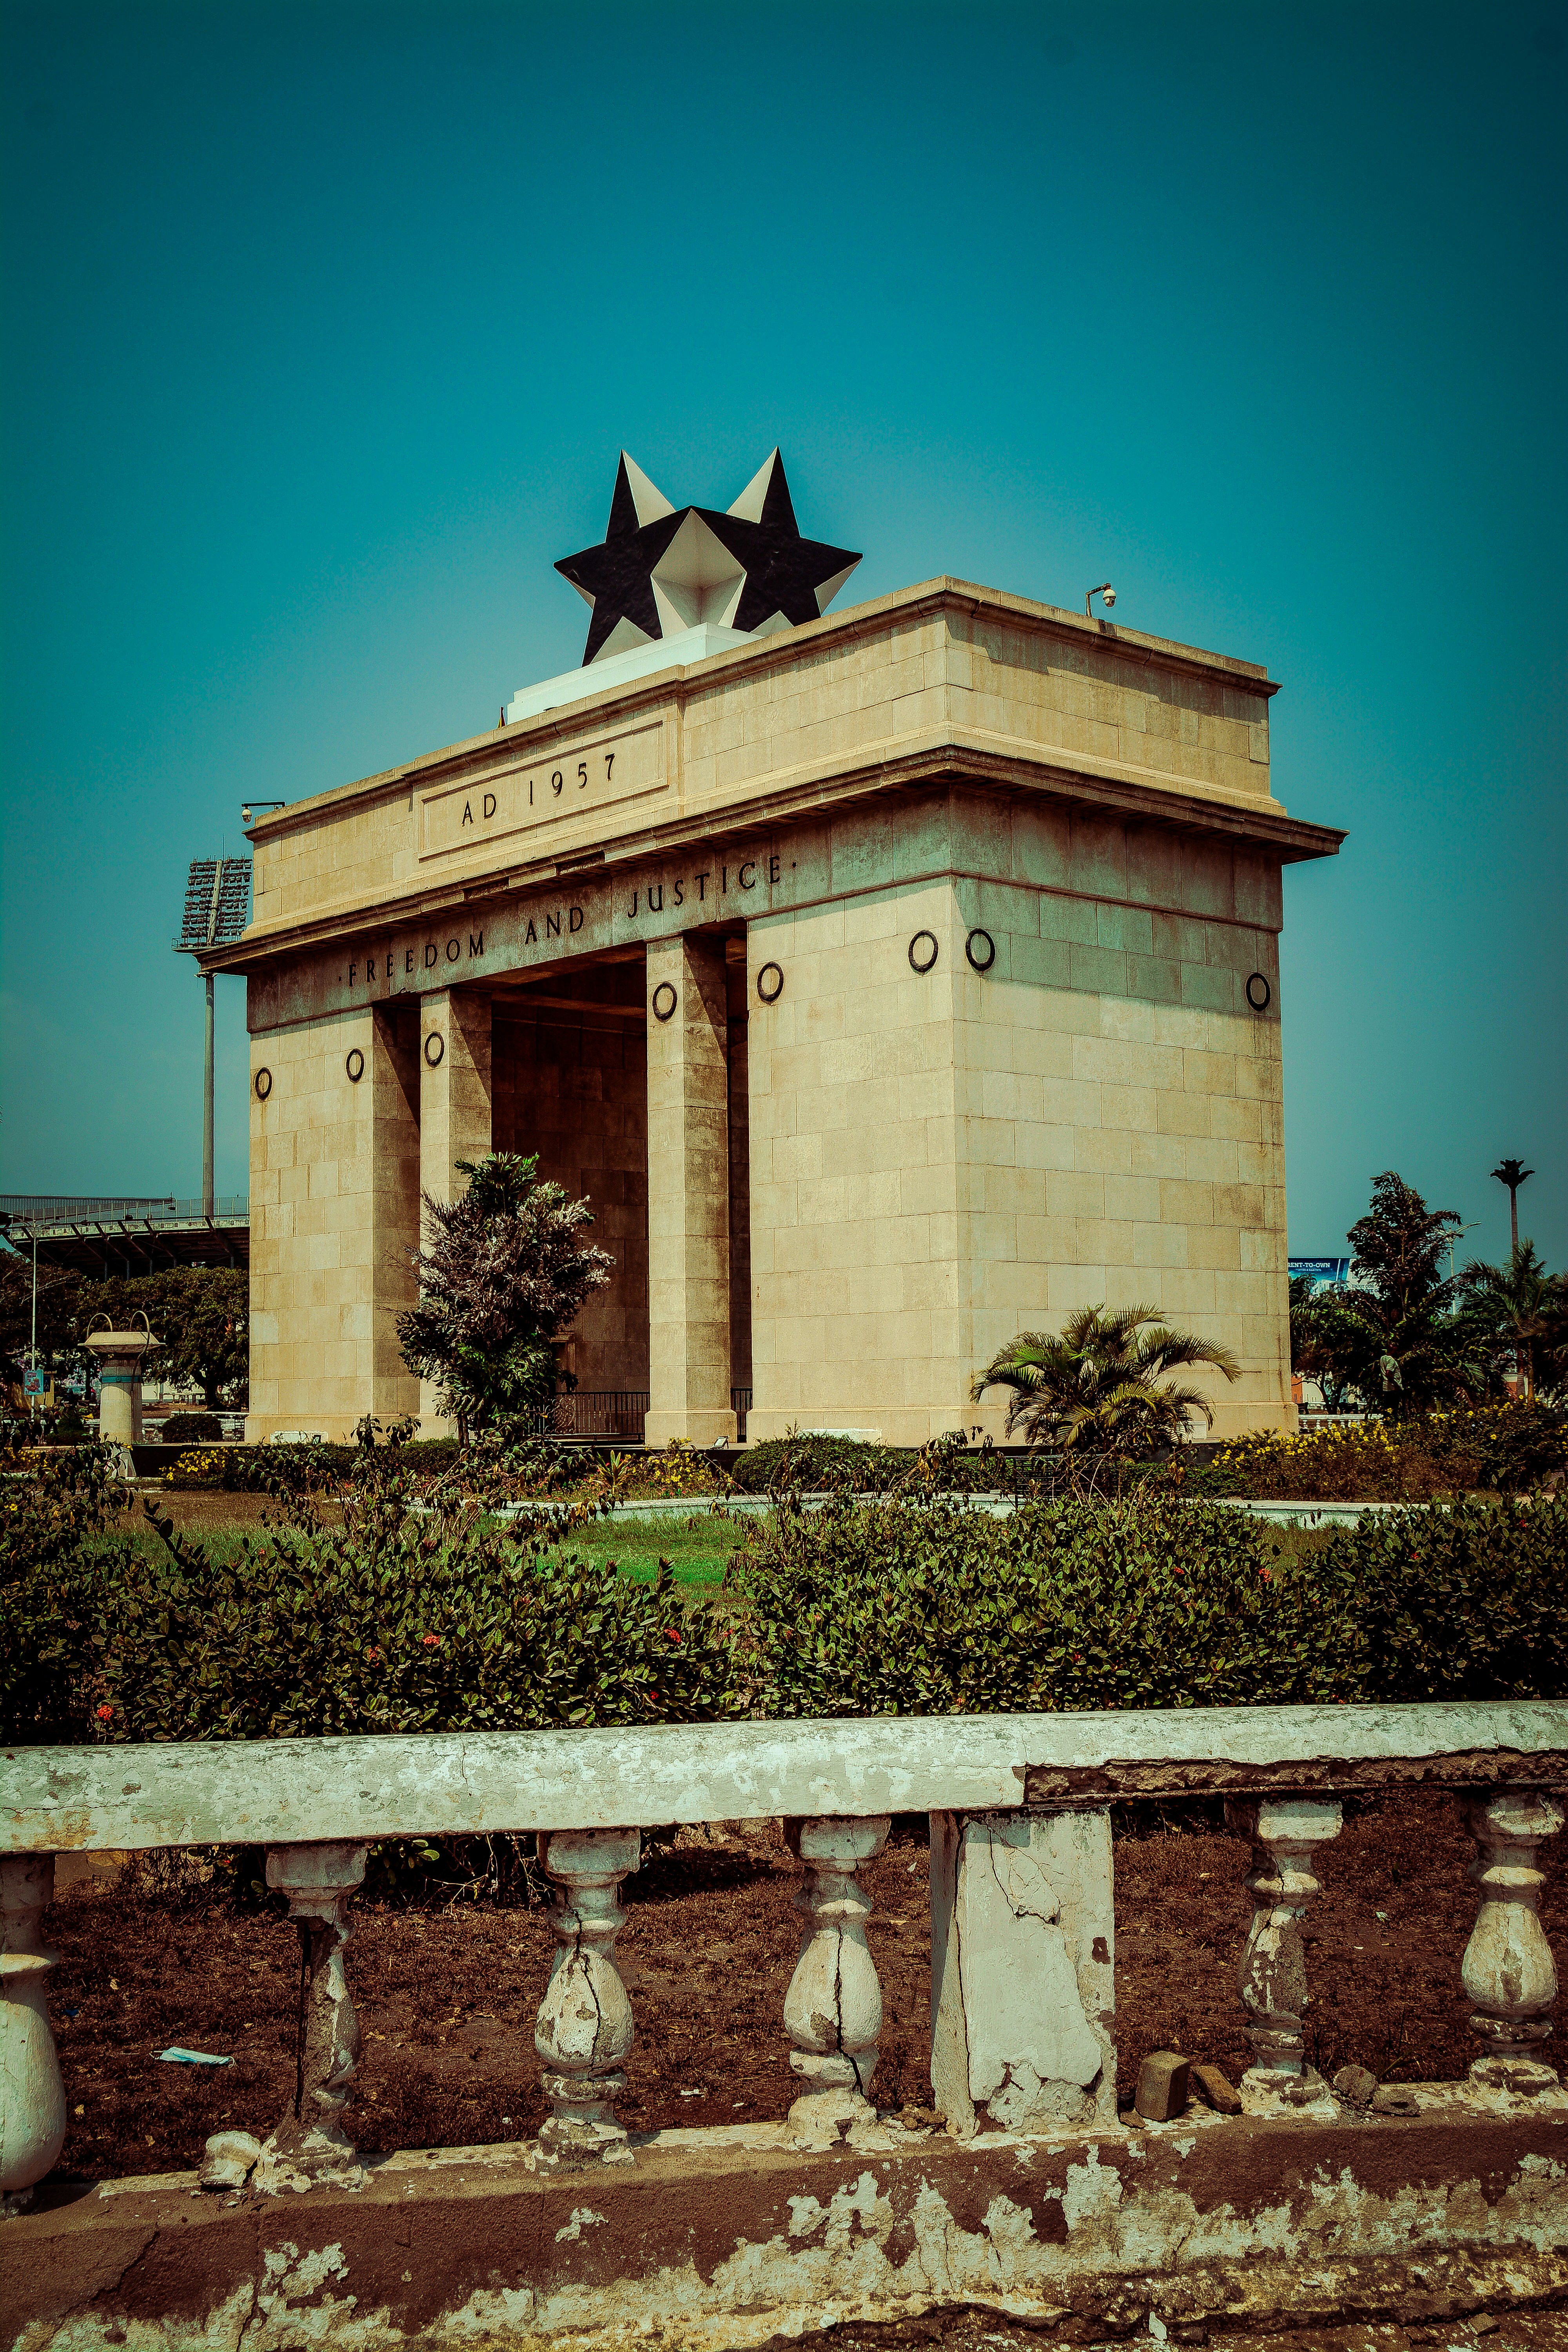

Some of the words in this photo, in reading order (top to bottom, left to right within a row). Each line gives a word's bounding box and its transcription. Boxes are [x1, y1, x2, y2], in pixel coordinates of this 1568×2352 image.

[461, 793, 497, 826] AD
[529, 753, 615, 806] 1957
[348, 931, 485, 987] FREEDOM
[524, 906, 584, 945] AND
[628, 855, 780, 918] JUSTICE
